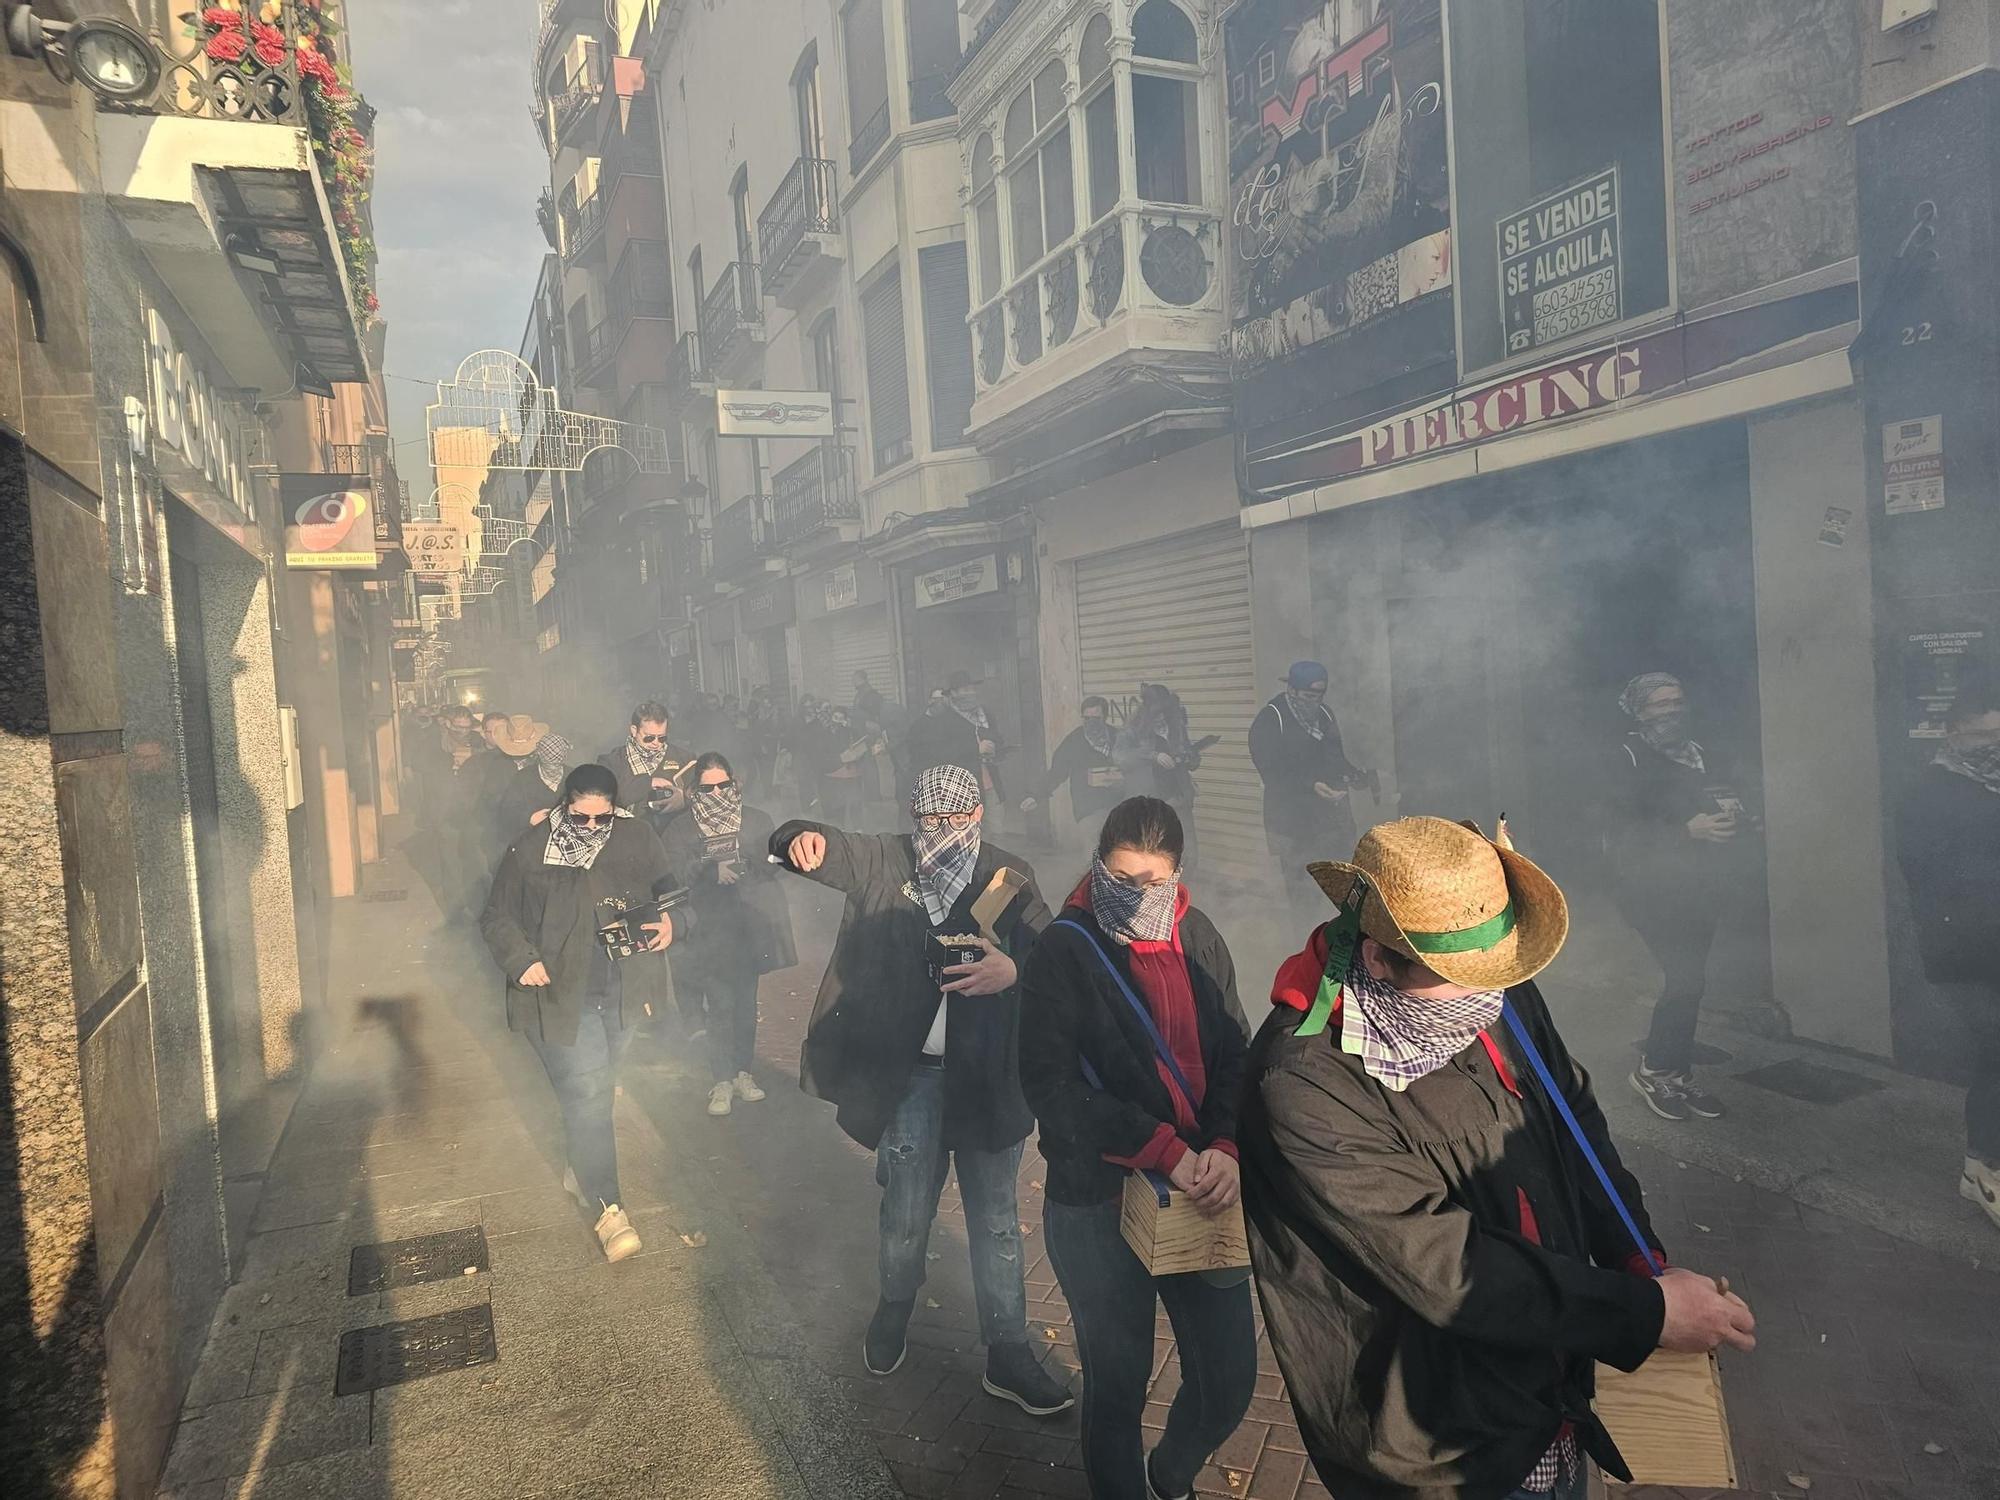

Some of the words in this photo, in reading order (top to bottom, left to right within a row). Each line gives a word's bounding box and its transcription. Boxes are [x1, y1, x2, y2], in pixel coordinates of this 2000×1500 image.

[1685, 112, 1764, 152] TATTOO
[1504, 217, 1531, 256] SE
[1535, 181, 1612, 242] VENDE
[1507, 261, 1529, 297] SE
[1534, 227, 1614, 287] ALQUILA
[1534, 269, 1613, 319] 660324539
[1536, 294, 1616, 343] 646583968
[1902, 322, 1932, 345] 22
[1360, 347, 1642, 468] PIERCING
[1888, 458, 1941, 475] Alarma
[405, 535, 454, 550] J.@.S.
[1922, 640, 1939, 649] CON
